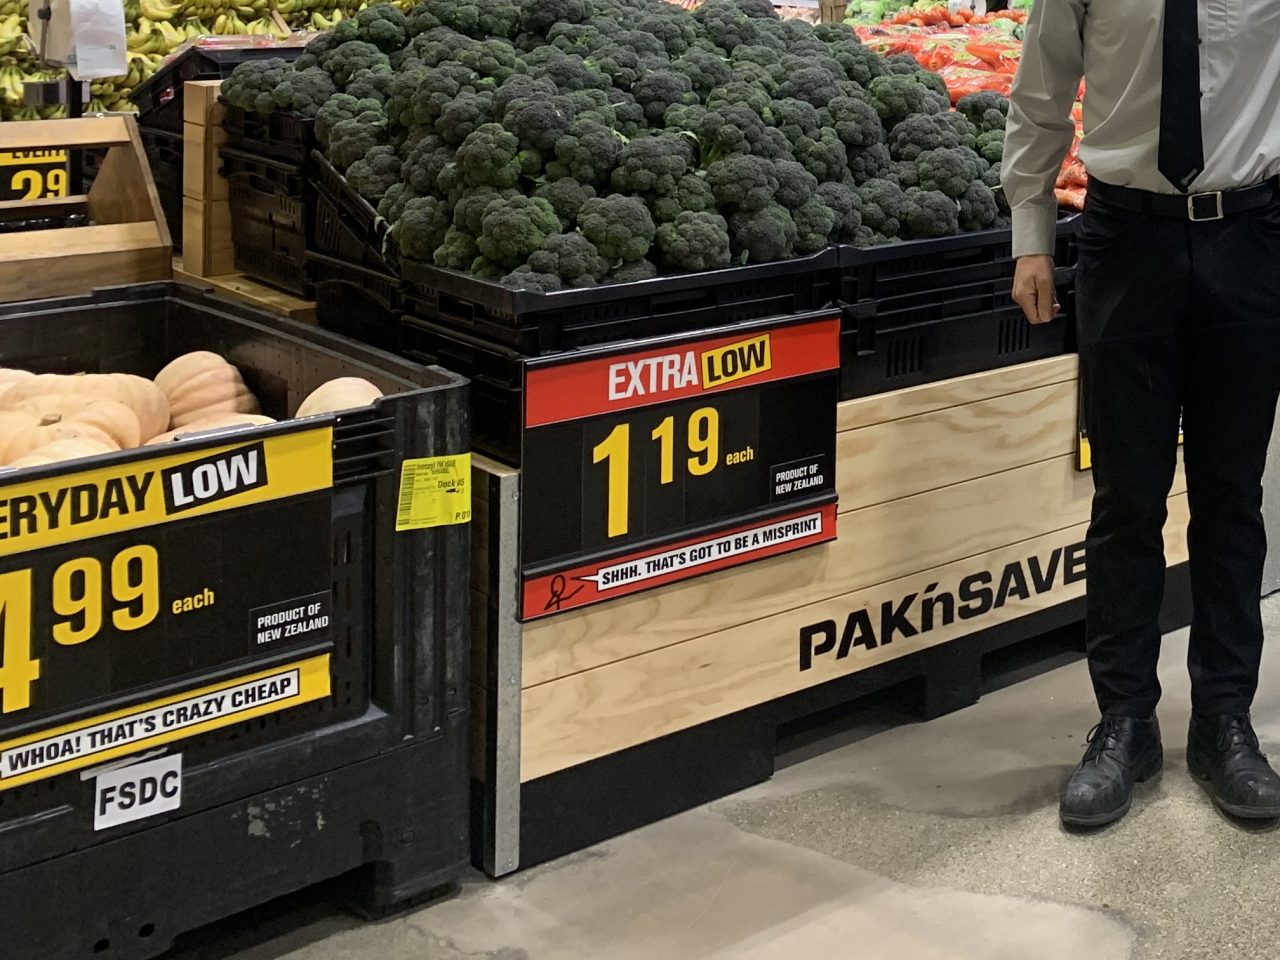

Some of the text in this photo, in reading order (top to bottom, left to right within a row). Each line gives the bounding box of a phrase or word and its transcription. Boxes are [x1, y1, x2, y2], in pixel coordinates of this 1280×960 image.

[608, 340, 766, 401] EXTRA LOW
[726, 446, 754, 466] each
[170, 450, 258, 507] LOW
[775, 474, 824, 495] NEW ZEALAND
[776, 464, 819, 483] PRODUCT OF
[602, 517, 819, 585] SHHH. THAT'S GOT TO BE A MISPRINT
[172, 588, 214, 614] each
[257, 602, 321, 629] PRODUCT OF
[257, 615, 329, 644] NEW ZEALAND
[8, 677, 292, 771] WHOA! THAT'S CRAZY CHEAP
[98, 770, 179, 817] FSDC
